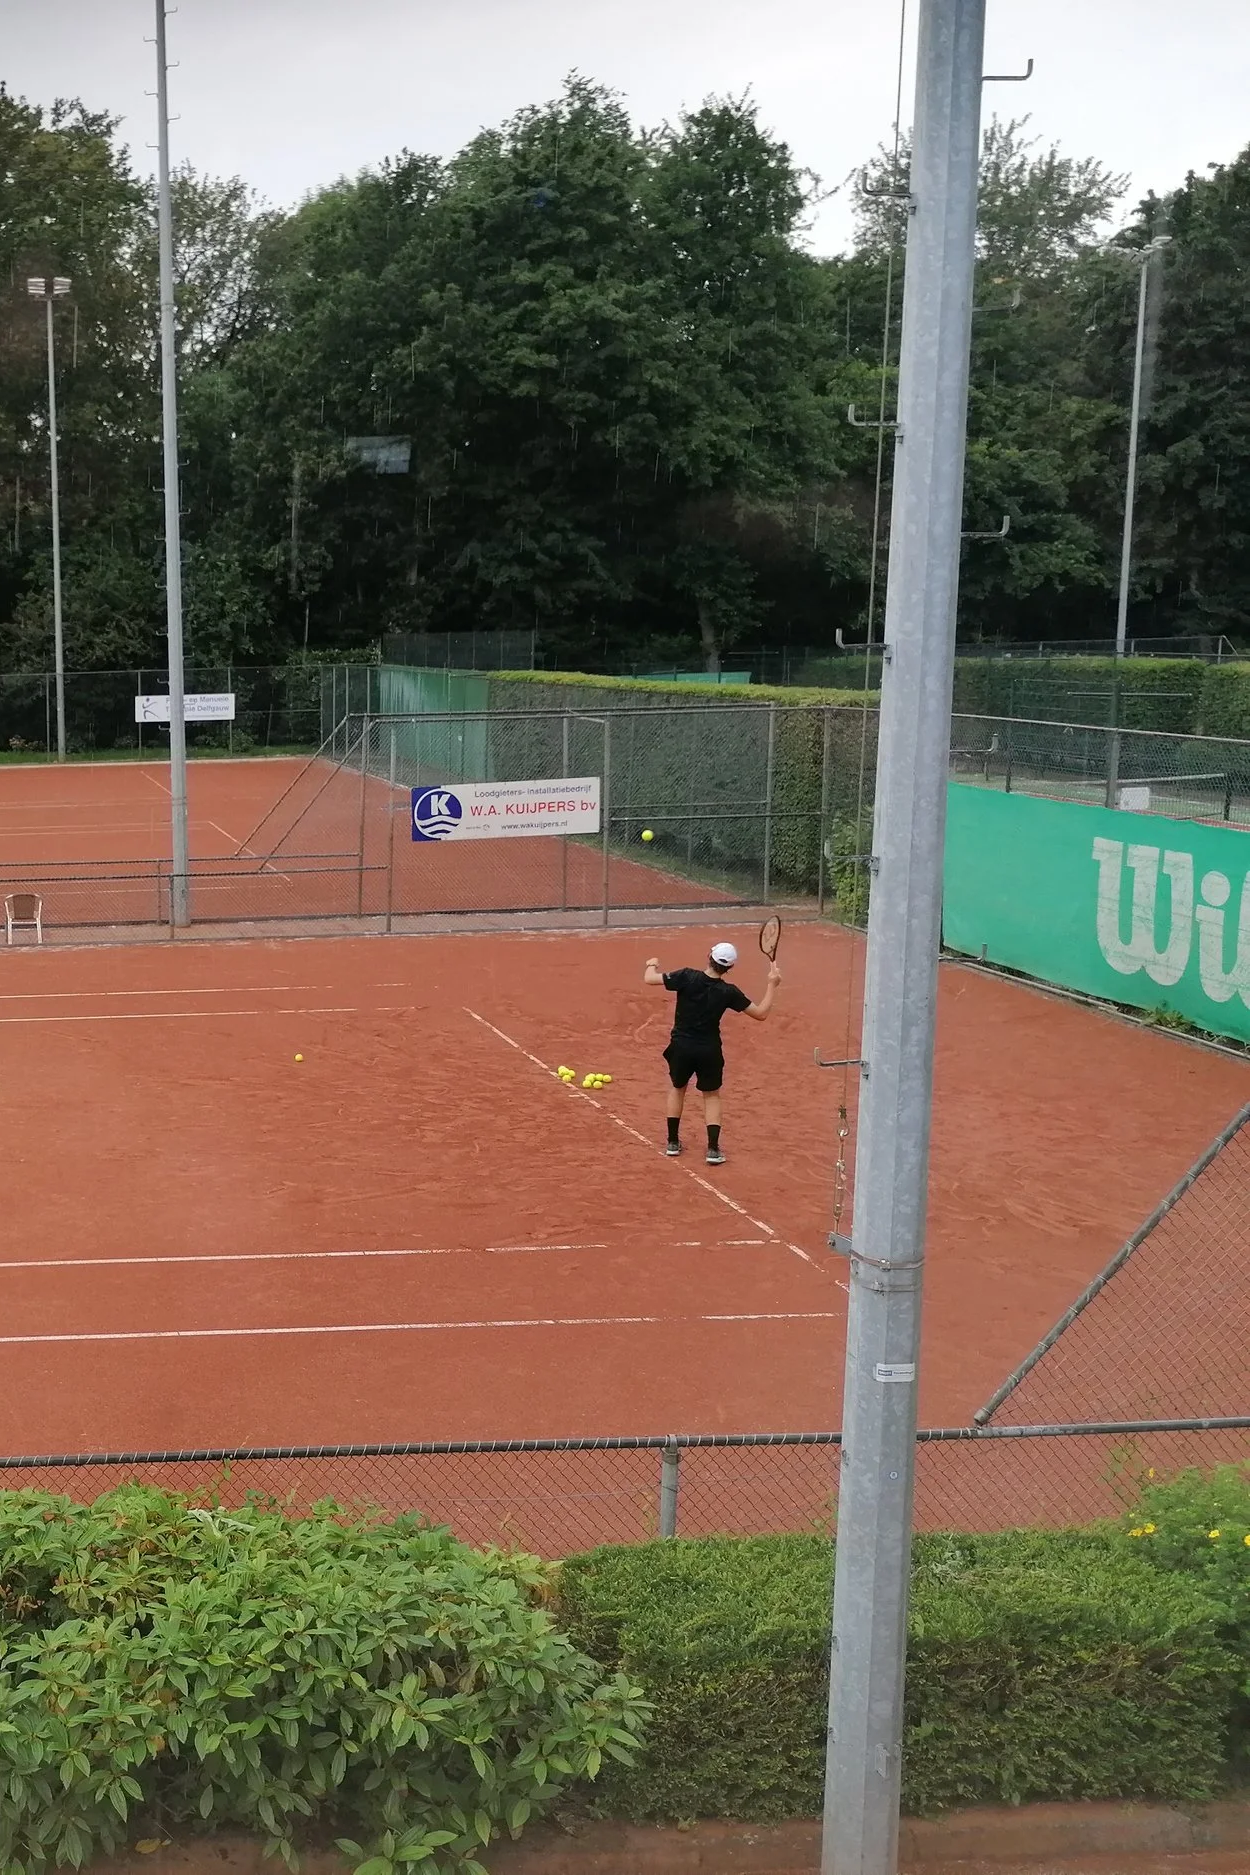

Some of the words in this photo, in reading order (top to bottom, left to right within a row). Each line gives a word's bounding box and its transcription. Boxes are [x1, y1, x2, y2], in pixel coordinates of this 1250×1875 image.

[431, 794, 451, 816] K
[470, 805, 501, 816] W.A.
[505, 800, 576, 815] KUIJPERS
[580, 800, 597, 811] bv
